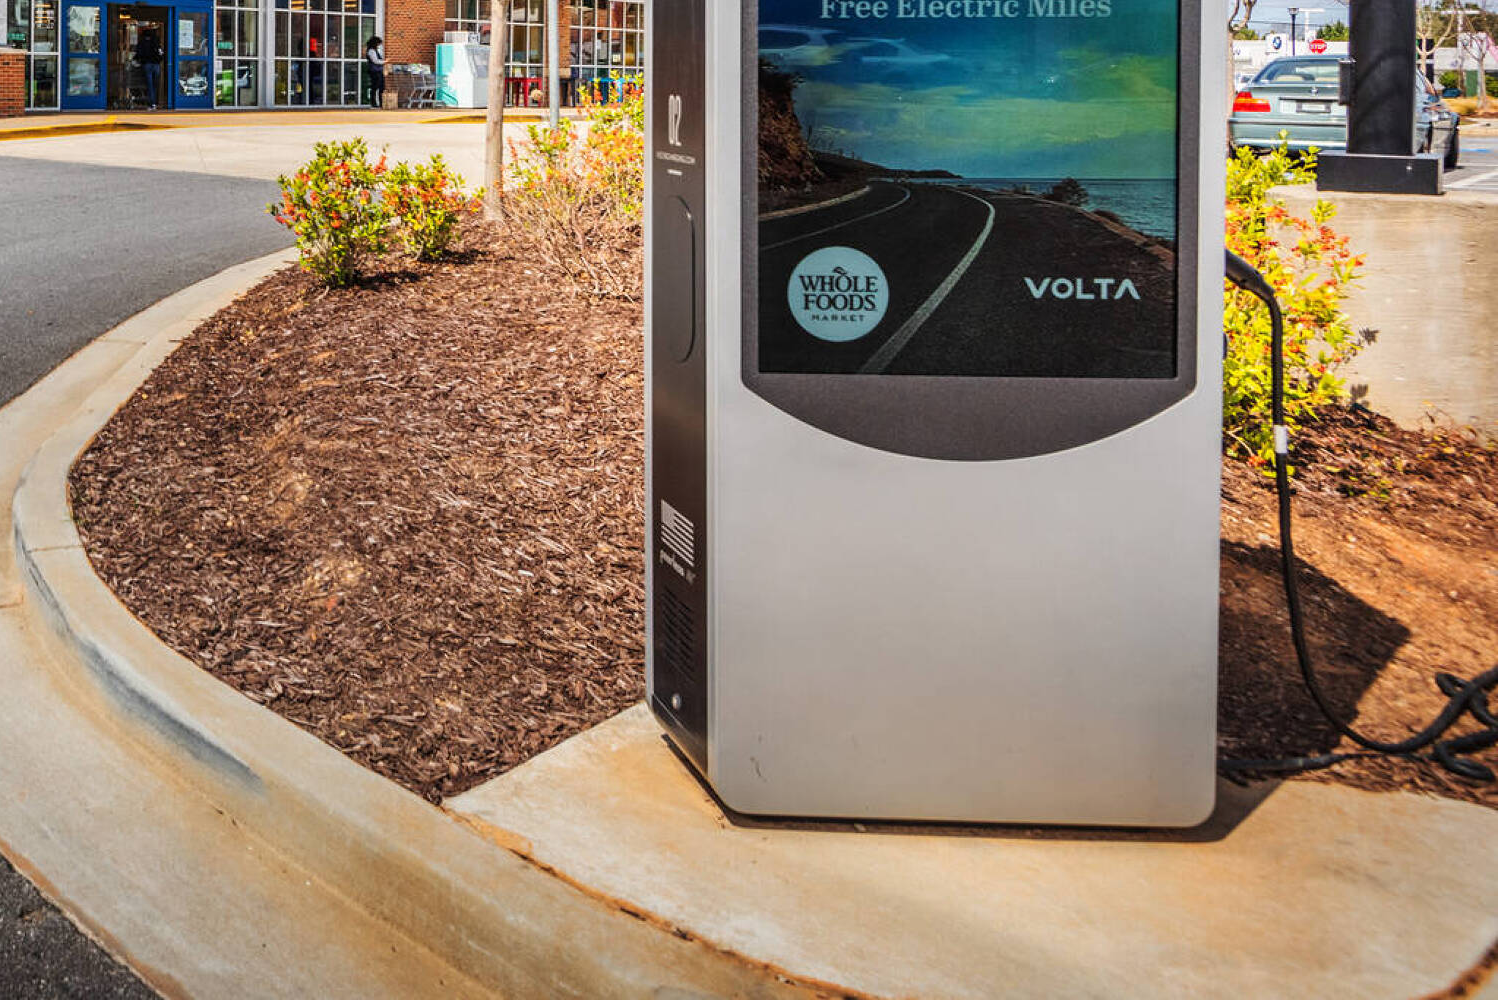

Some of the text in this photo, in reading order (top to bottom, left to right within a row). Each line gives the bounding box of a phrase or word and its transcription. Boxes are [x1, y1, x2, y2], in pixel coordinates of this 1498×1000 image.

[799, 266, 878, 292] WHOLE
[1023, 276, 1141, 300] VOLTA
[803, 294, 877, 311] FOODS
[811, 314, 866, 322] MARKET
